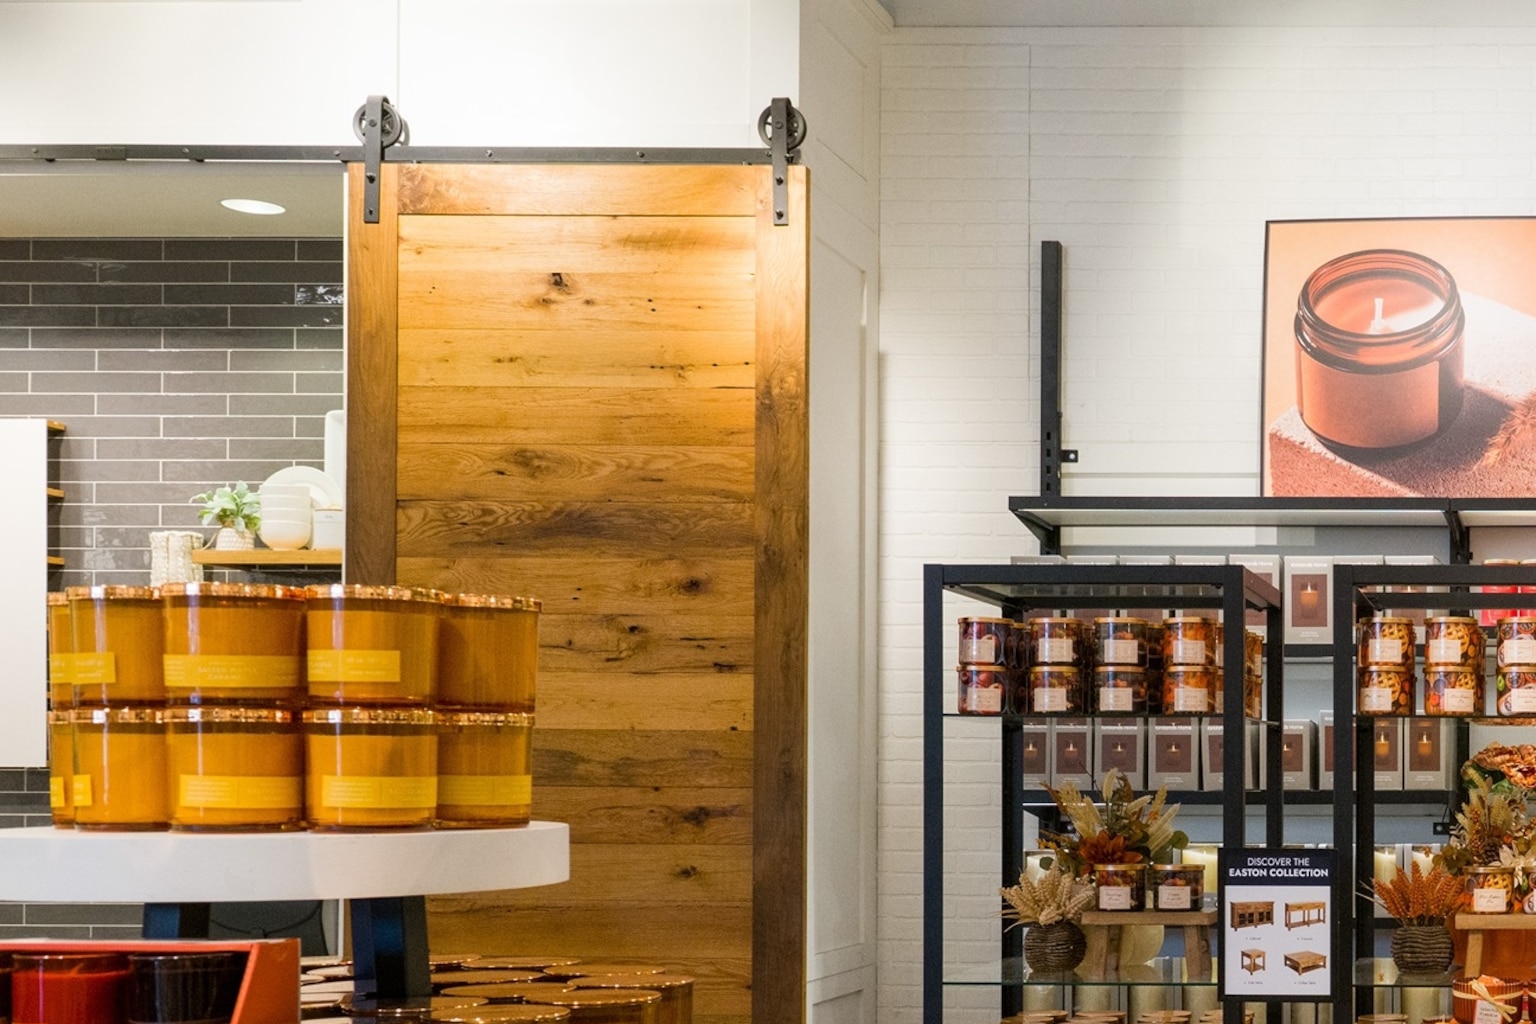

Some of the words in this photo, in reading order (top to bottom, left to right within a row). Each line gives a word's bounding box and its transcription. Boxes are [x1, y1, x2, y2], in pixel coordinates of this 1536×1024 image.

[1247, 857, 1291, 867] DISCOVER
[1293, 857, 1310, 867] THE
[1229, 867, 1267, 877] EASTON
[1269, 867, 1329, 877] COLLECTION
